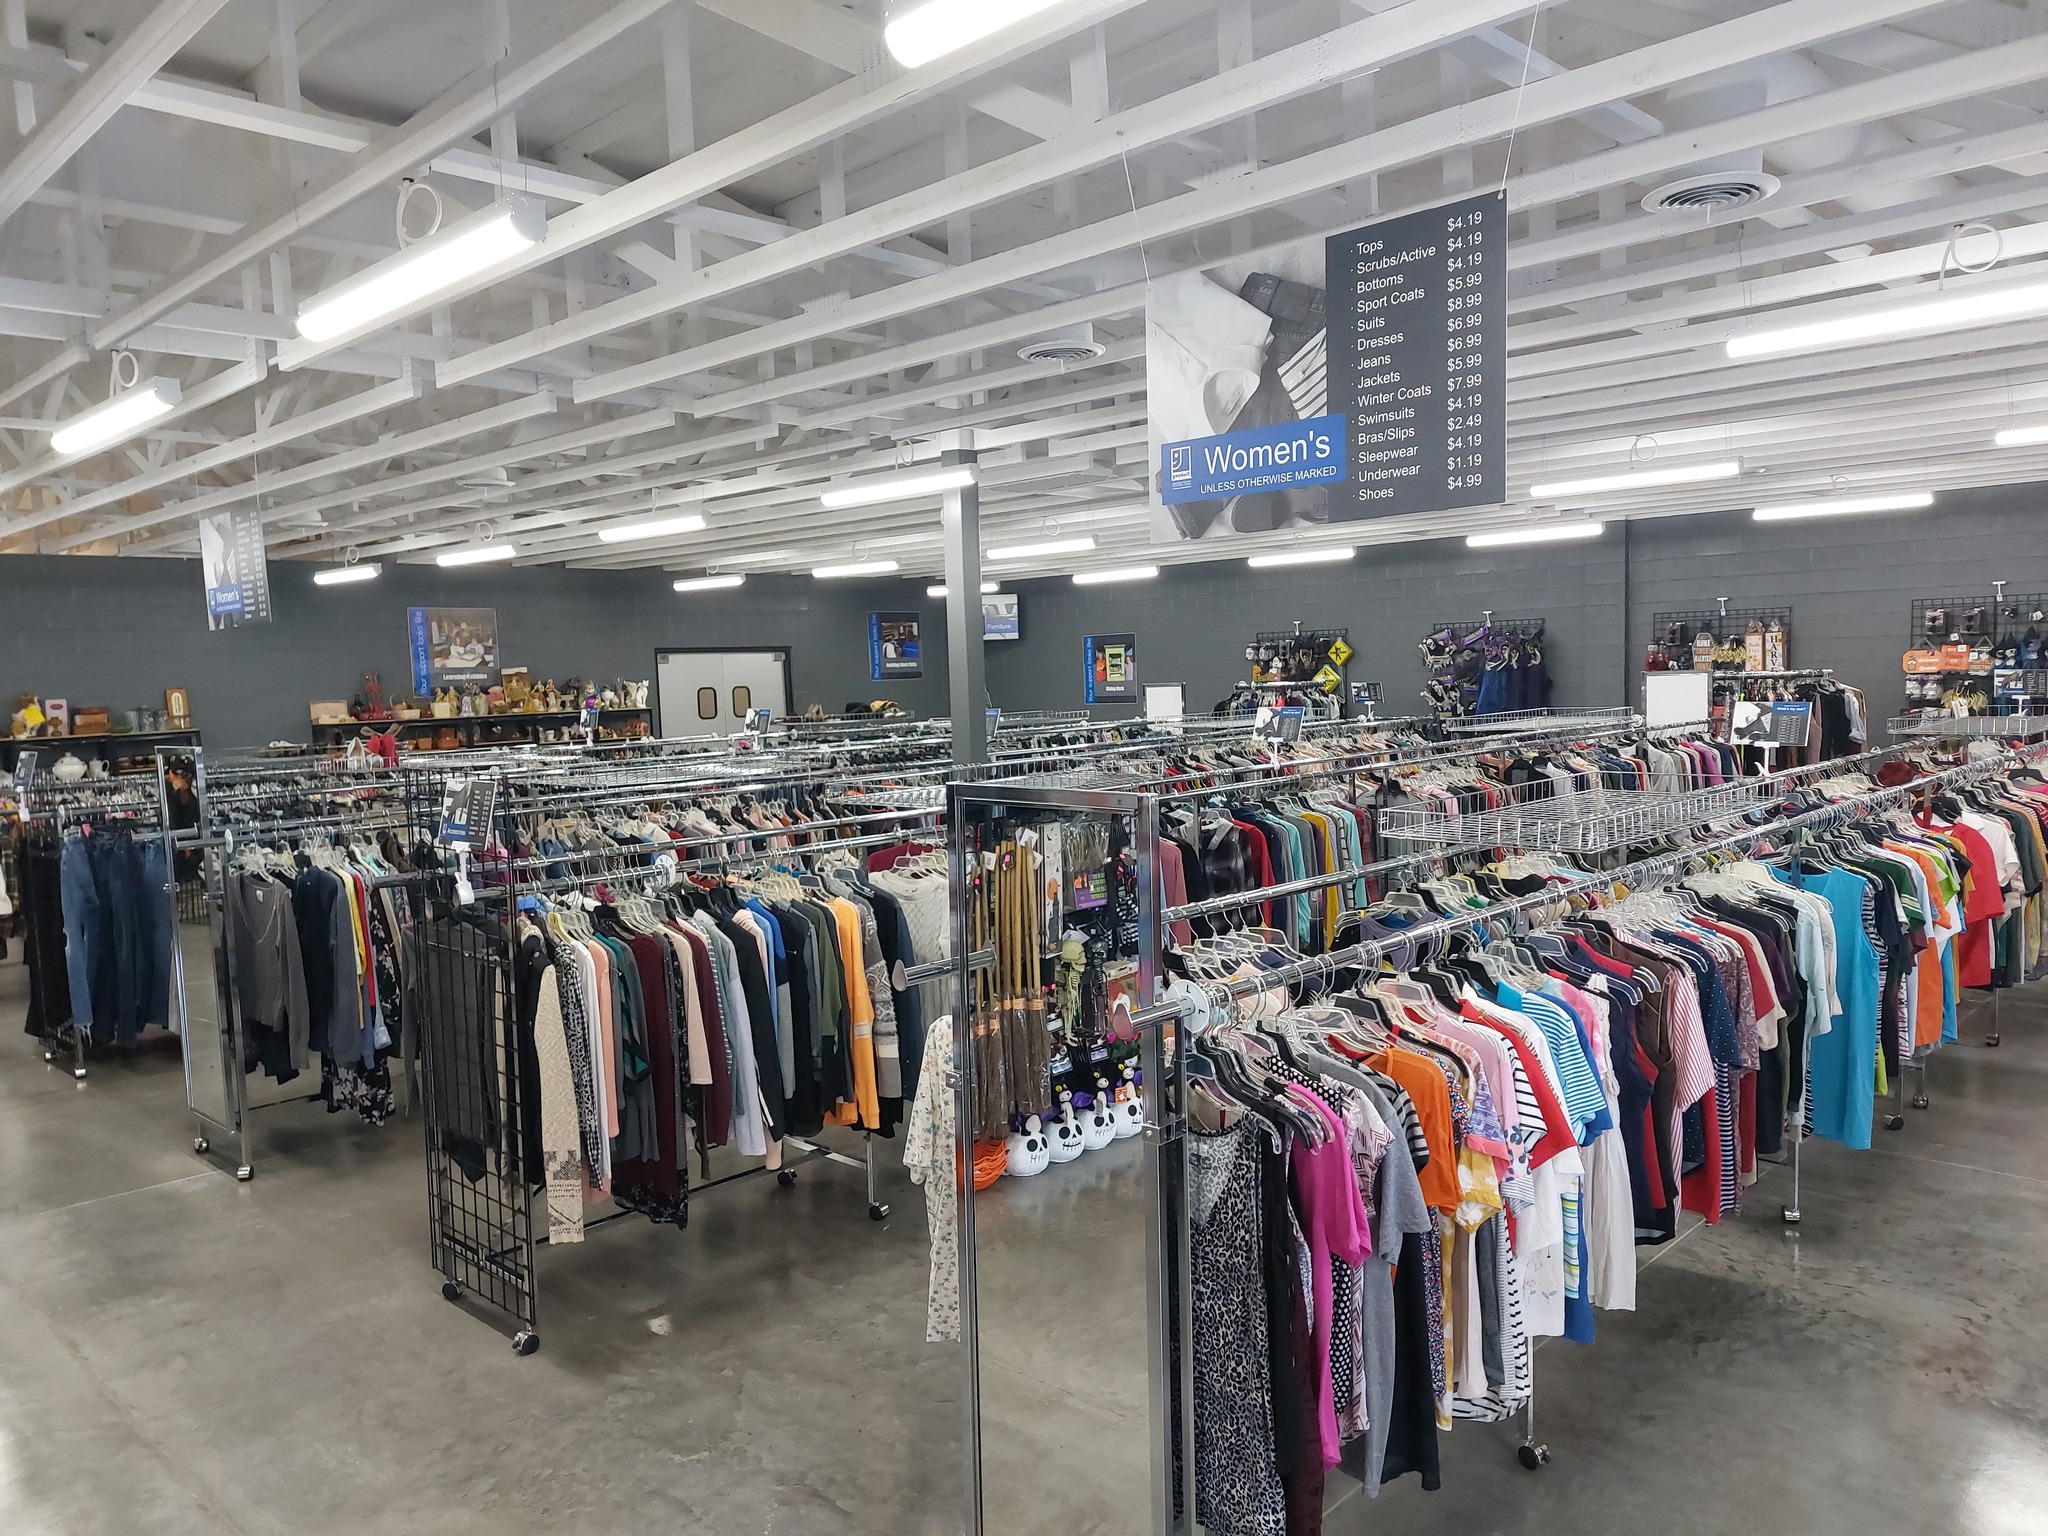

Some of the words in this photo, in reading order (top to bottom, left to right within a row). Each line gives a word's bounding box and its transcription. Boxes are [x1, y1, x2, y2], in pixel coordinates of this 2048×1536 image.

[1357, 240, 1383, 255] Tops
[1447, 211, 1482, 232] $4.19
[1357, 246, 1436, 274] Scrubs/Active
[1447, 231, 1482, 252] $4.19
[1357, 273, 1404, 293] Bottoms
[1447, 252, 1482, 272] $4.19
[1357, 295, 1387, 313] Sport
[1391, 288, 1425, 304] Coats
[1447, 272, 1482, 292] $5.99
[1357, 316, 1385, 331] Suits
[1447, 293, 1482, 312] $8.99
[1357, 332, 1404, 350] Dresses
[1447, 313, 1482, 332] $6.99
[1357, 354, 1391, 370] Jeans
[1447, 333, 1482, 352] $6.99
[1357, 371, 1400, 389] Jackets
[1447, 353, 1482, 372] $5.99
[1358, 392, 1394, 407] Winter
[1397, 384, 1432, 400] Coats
[1447, 373, 1482, 392] $7.99
[1358, 407, 1415, 426] Swimsuits
[1447, 393, 1482, 412] $4.19
[1358, 426, 1415, 445] Bras/Slips
[1447, 413, 1482, 431] $2.49
[1204, 430, 1331, 475] Women's
[1358, 445, 1418, 463] Sleepwear
[1447, 433, 1482, 451] $4.19
[1200, 481, 1235, 494] UNLESS
[1237, 473, 1293, 490] OTHERWISE
[1295, 465, 1337, 480] MARKED
[1358, 464, 1421, 482] Underwear
[1447, 453, 1482, 470] $1.19
[1359, 487, 1394, 501] Shoes
[1447, 473, 1482, 490] $4.99
[216, 588, 240, 604] Women's
[416, 625, 424, 645] looks
[418, 646, 427, 676] support
